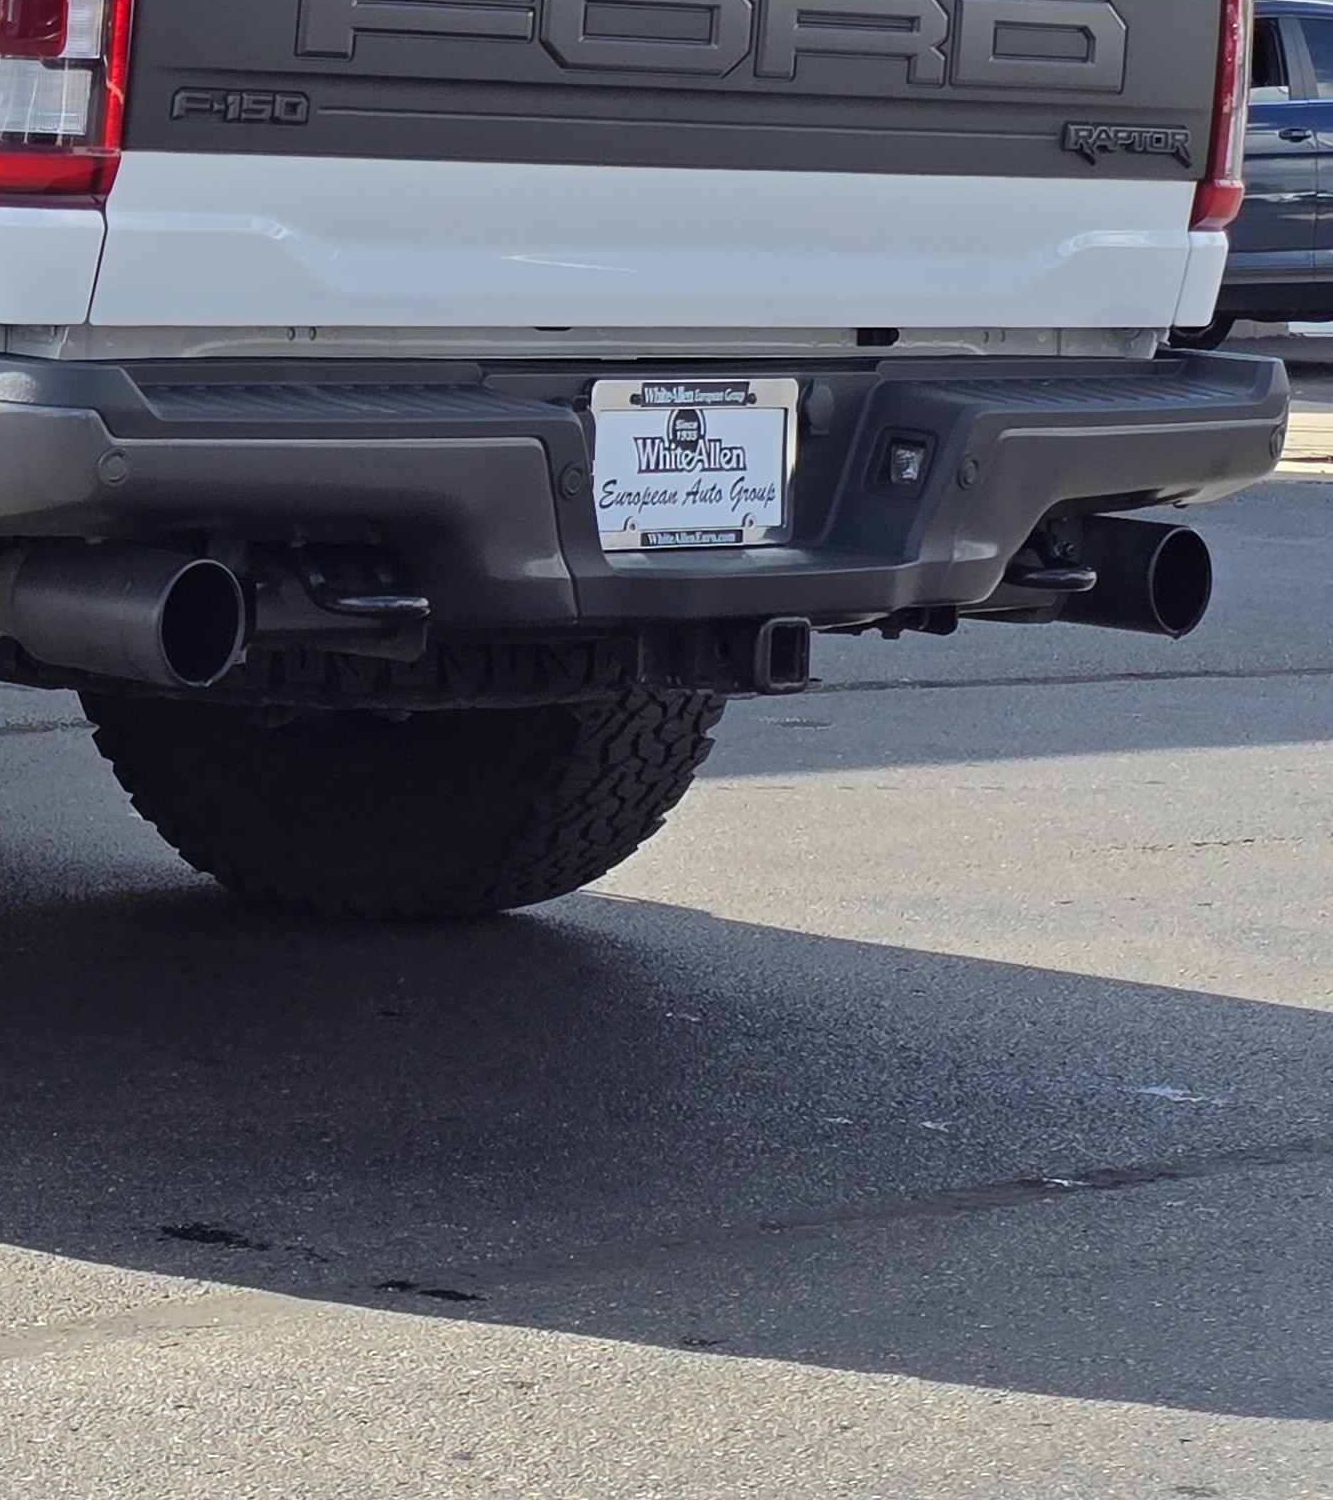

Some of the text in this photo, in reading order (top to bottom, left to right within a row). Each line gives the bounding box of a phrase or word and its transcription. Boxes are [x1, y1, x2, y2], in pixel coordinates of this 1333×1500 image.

[171, 86, 310, 126] F-150
[1061, 121, 1193, 169] RAPTOR
[598, 476, 776, 513] European Auto Group
